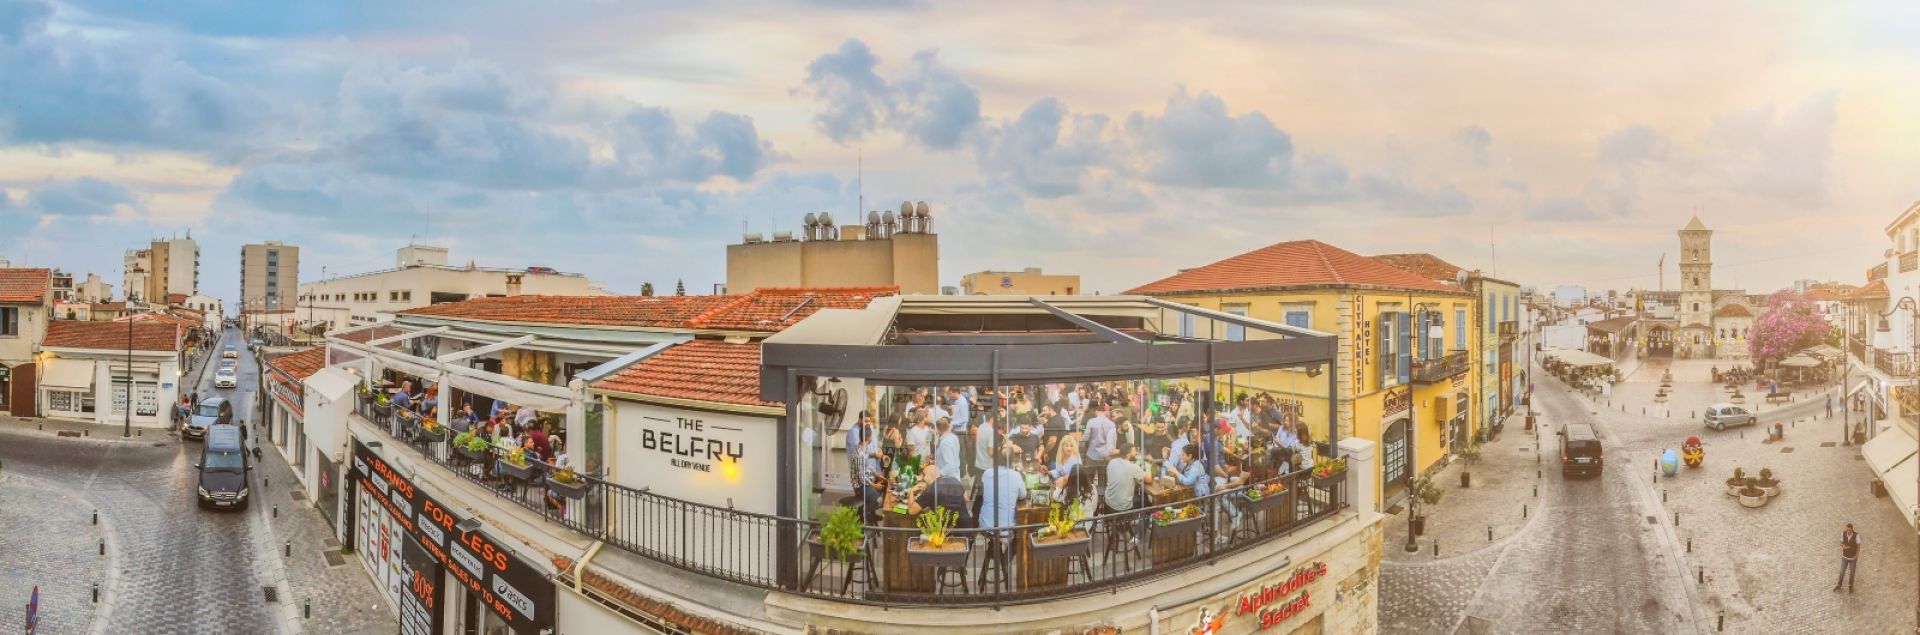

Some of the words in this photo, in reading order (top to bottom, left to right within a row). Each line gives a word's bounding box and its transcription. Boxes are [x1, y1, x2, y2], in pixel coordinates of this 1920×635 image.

[676, 417, 703, 431] THE
[643, 429, 743, 463] BELFRY
[375, 459, 414, 500] BRANDS
[424, 500, 454, 532] FOR
[461, 531, 508, 571] LESS
[414, 570, 434, 608] 80%
[448, 559, 469, 583] SALES
[470, 578, 480, 591] UP
[482, 588, 493, 603] TO
[495, 600, 512, 620] 80%
[1236, 561, 1327, 616] Aphrodite's
[1259, 590, 1310, 631] Secret
